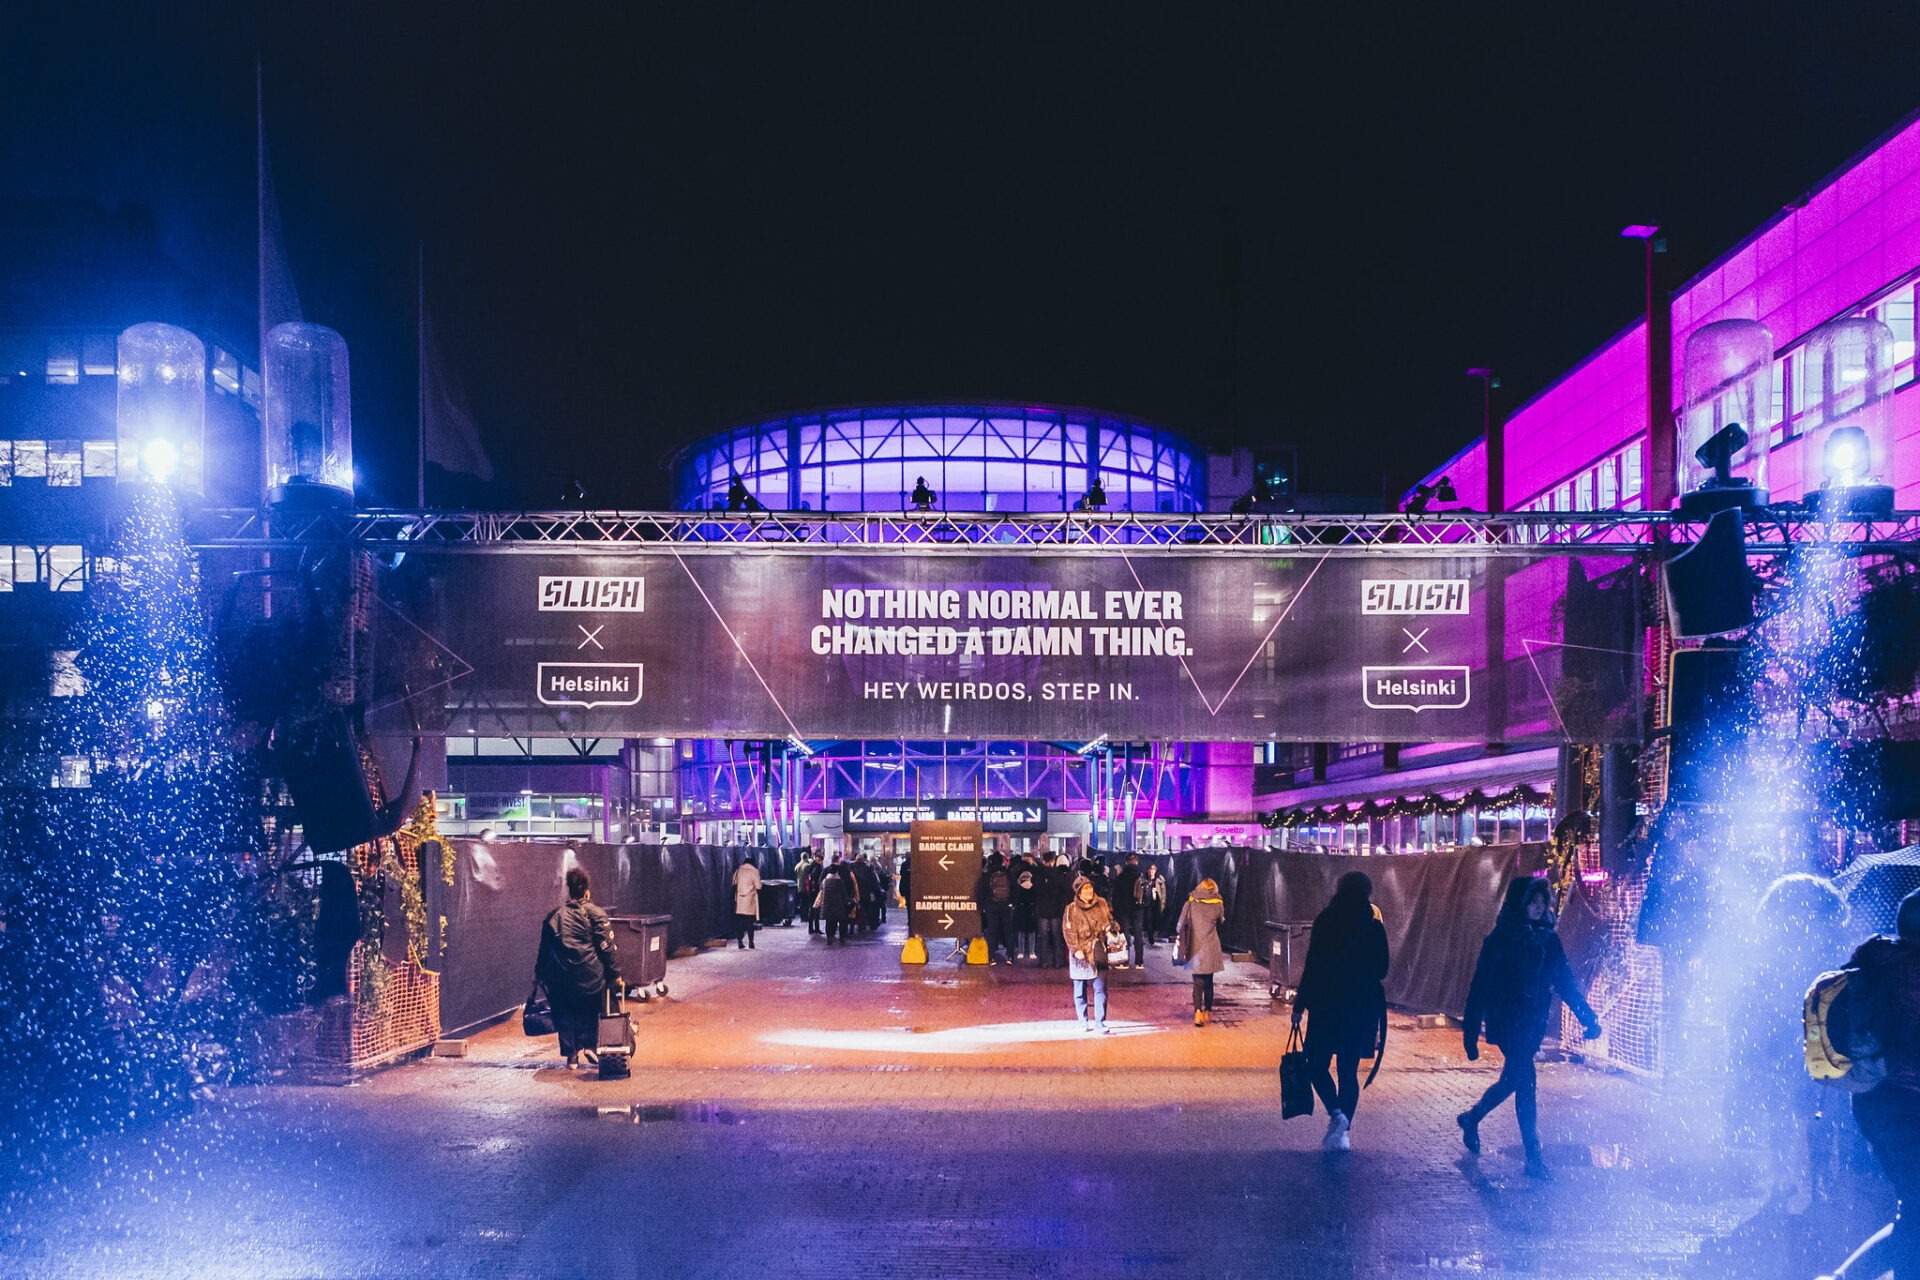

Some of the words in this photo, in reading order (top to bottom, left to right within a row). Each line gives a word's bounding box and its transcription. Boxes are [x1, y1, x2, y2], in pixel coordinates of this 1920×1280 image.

[543, 580, 640, 608] SLUSH
[1366, 583, 1464, 610] SLUSH
[821, 589, 960, 620] NOTHING
[967, 589, 1098, 620] NORMAL
[1103, 590, 1183, 621] EVER
[810, 625, 957, 656] CHANGED
[963, 626, 985, 655] A
[991, 626, 1083, 656] DAMN
[1089, 626, 1194, 657] THING.
[551, 676, 630, 692] Helsinki
[864, 682, 909, 699] HEY
[917, 682, 1033, 702] WEIRDOS,
[1042, 682, 1101, 700] STEP
[1109, 682, 1140, 700] IN.
[1376, 679, 1456, 695] Helsinki
[866, 811, 901, 823] BADGE
[982, 811, 1024, 823] HOLDER
[919, 842, 947, 852] BADGE
[947, 842, 974, 852] CLAIM
[915, 901, 943, 911] BADGE
[944, 901, 977, 911] HOLDER
